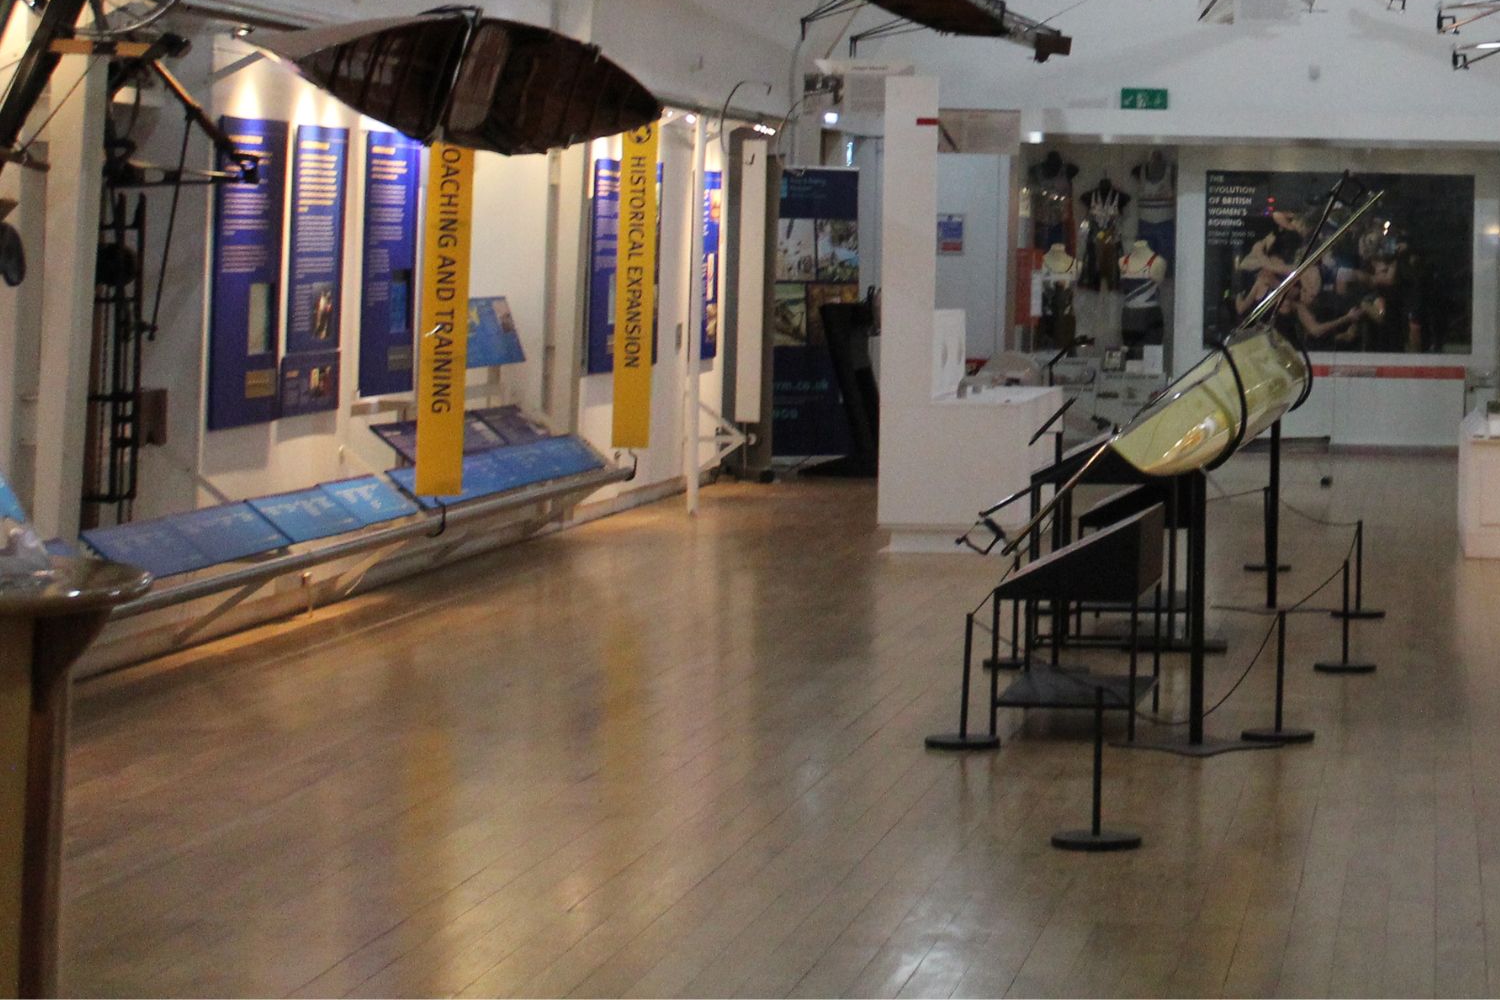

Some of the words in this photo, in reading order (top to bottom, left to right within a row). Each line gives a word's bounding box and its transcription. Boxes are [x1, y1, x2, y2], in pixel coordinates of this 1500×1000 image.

[437, 145, 461, 248] OACHING
[627, 156, 646, 260] HISTORICAL
[1208, 186, 1256, 194] EVOLUTION
[1208, 197, 1221, 205] OF
[1222, 197, 1252, 205] BRITISH
[1208, 207, 1248, 216] WOMEN'S
[436, 254, 456, 302] AND
[623, 265, 644, 369] EXPANSION
[431, 309, 455, 415] TRAINING
